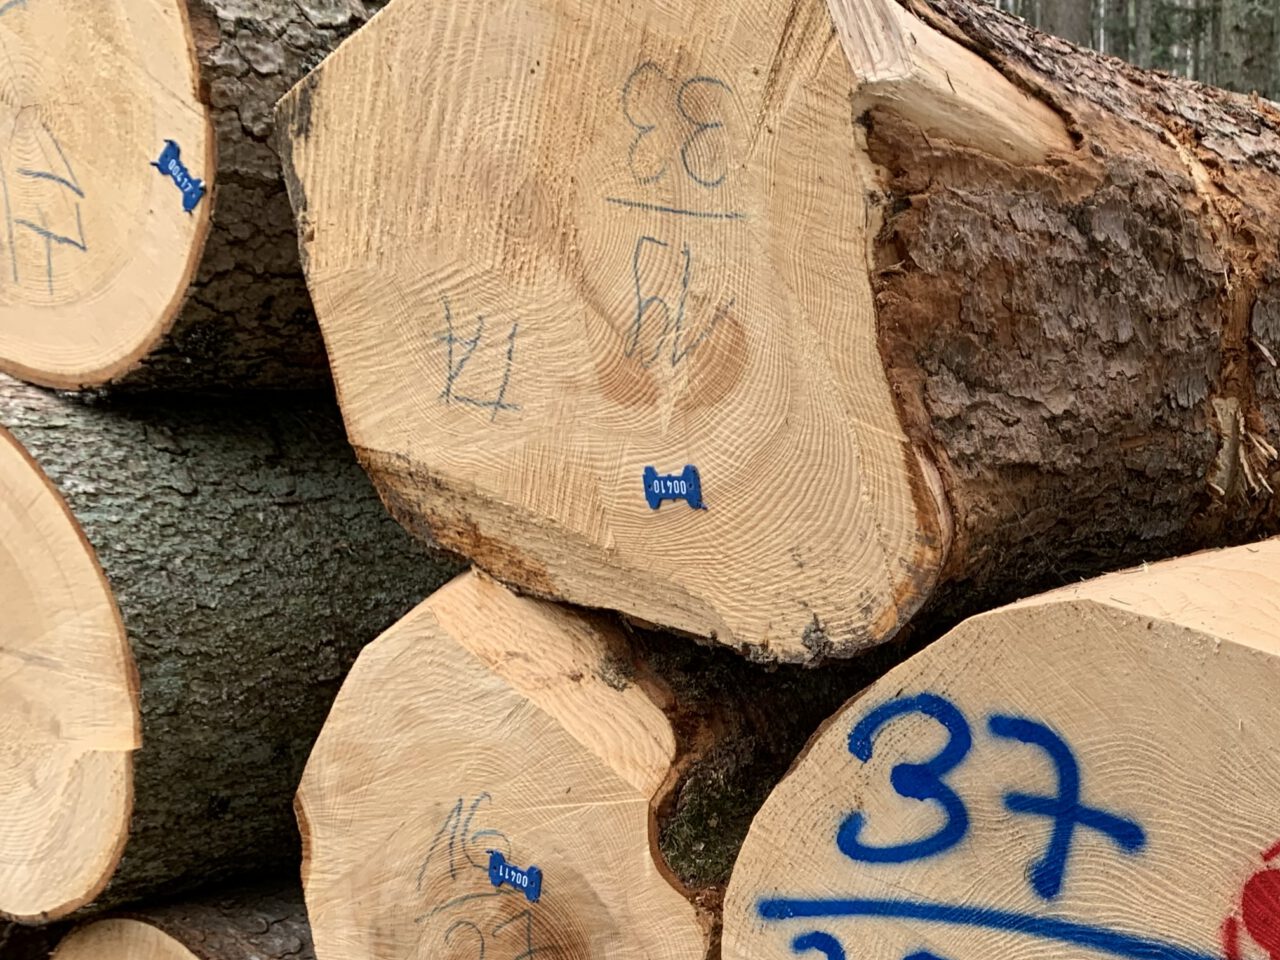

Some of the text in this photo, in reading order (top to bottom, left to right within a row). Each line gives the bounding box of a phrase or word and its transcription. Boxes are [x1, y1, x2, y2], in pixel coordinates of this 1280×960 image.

[167, 157, 192, 193] 00417
[650, 476, 687, 498] 00410
[837, 691, 1147, 901] 37
[499, 863, 530, 889] 00411
